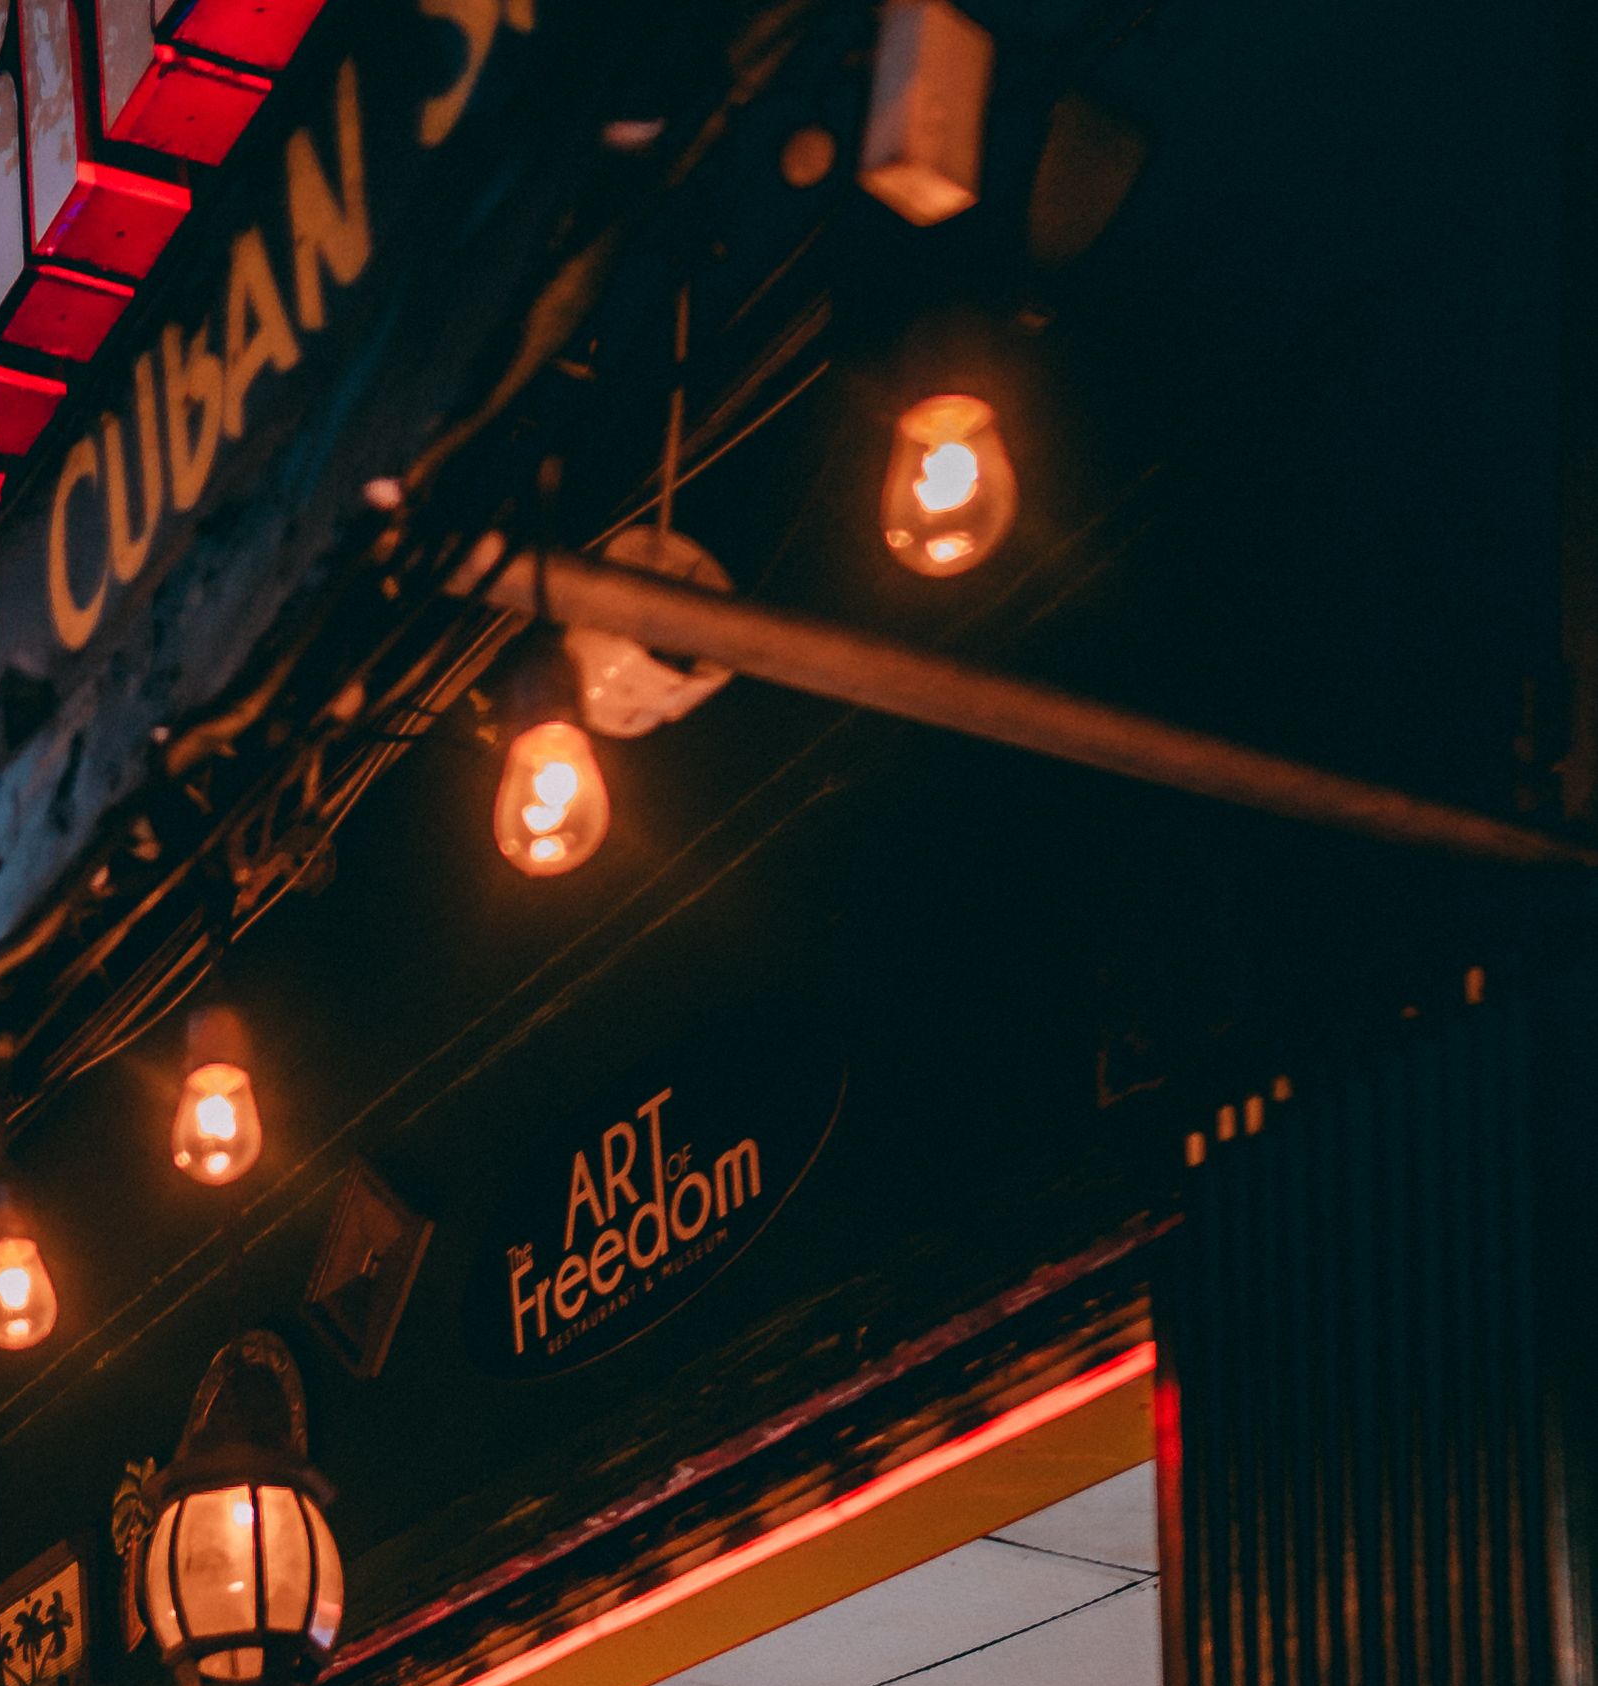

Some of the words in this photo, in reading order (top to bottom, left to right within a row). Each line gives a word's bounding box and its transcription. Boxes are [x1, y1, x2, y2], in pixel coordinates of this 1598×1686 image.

[48, 55, 373, 654] CUBAN
[509, 1138, 762, 1356] Freedom
[564, 1087, 672, 1254] ART
[665, 1143, 692, 1182] OF
